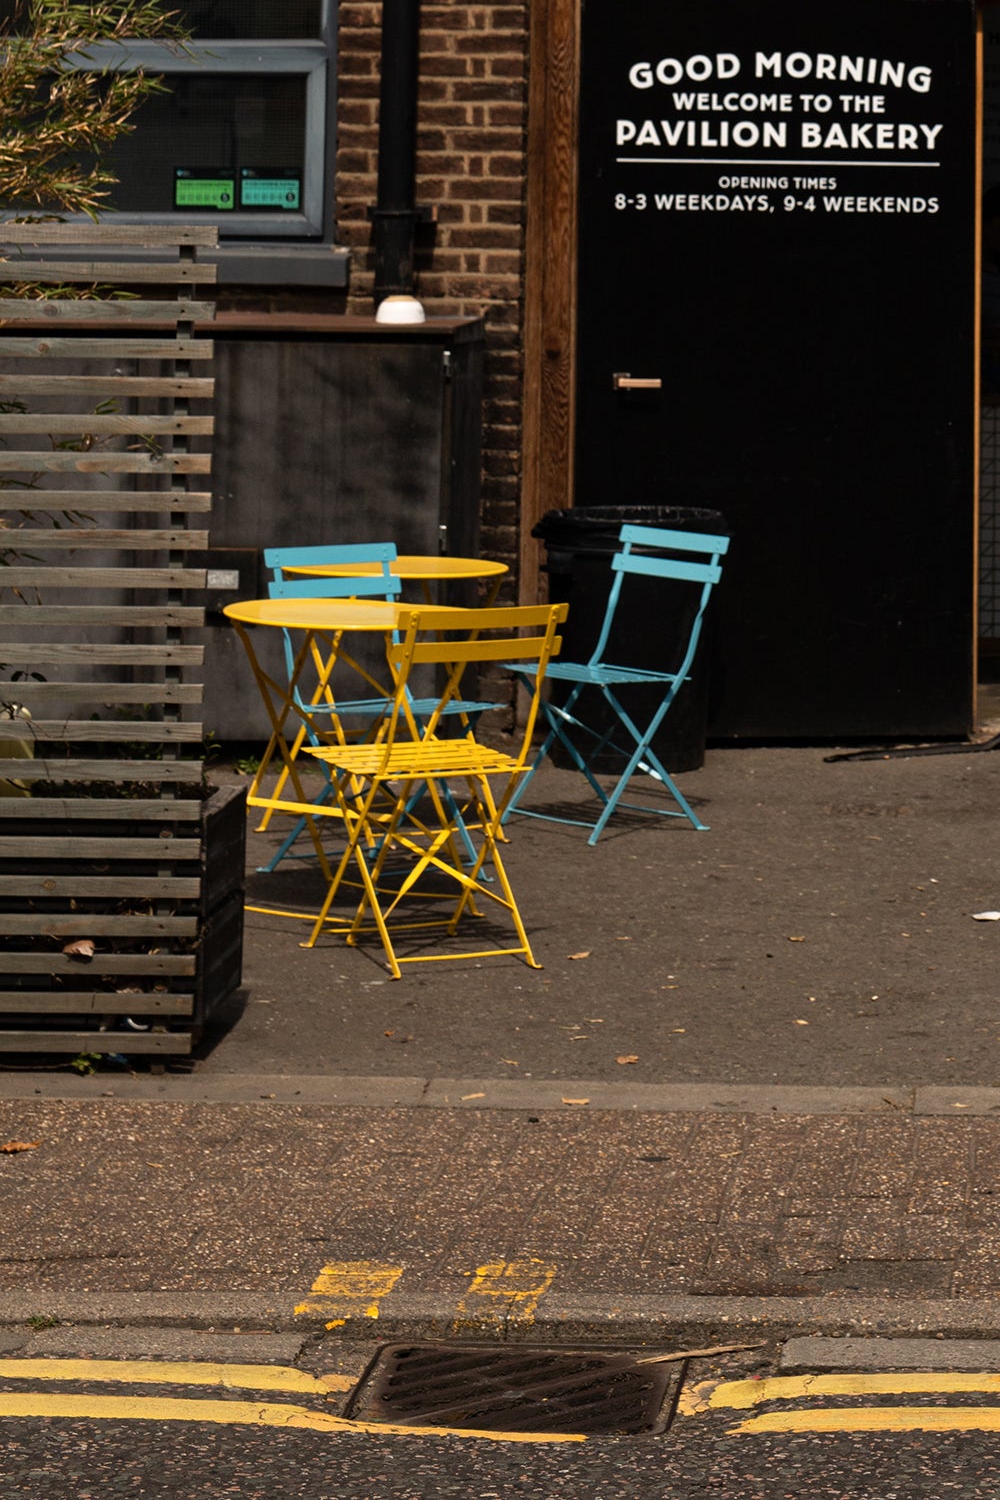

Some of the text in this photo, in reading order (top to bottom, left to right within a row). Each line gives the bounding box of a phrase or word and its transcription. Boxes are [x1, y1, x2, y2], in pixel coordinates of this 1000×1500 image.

[628, 51, 932, 93] GOOD MORNING
[672, 92, 886, 114] WELCOME TO THE
[616, 119, 944, 150] PAVILION BAKERY
[718, 175, 837, 190] OPENING TIMES
[614, 193, 940, 214] 8-3 WEEKDAYS, 9-4 WEEKENDS
